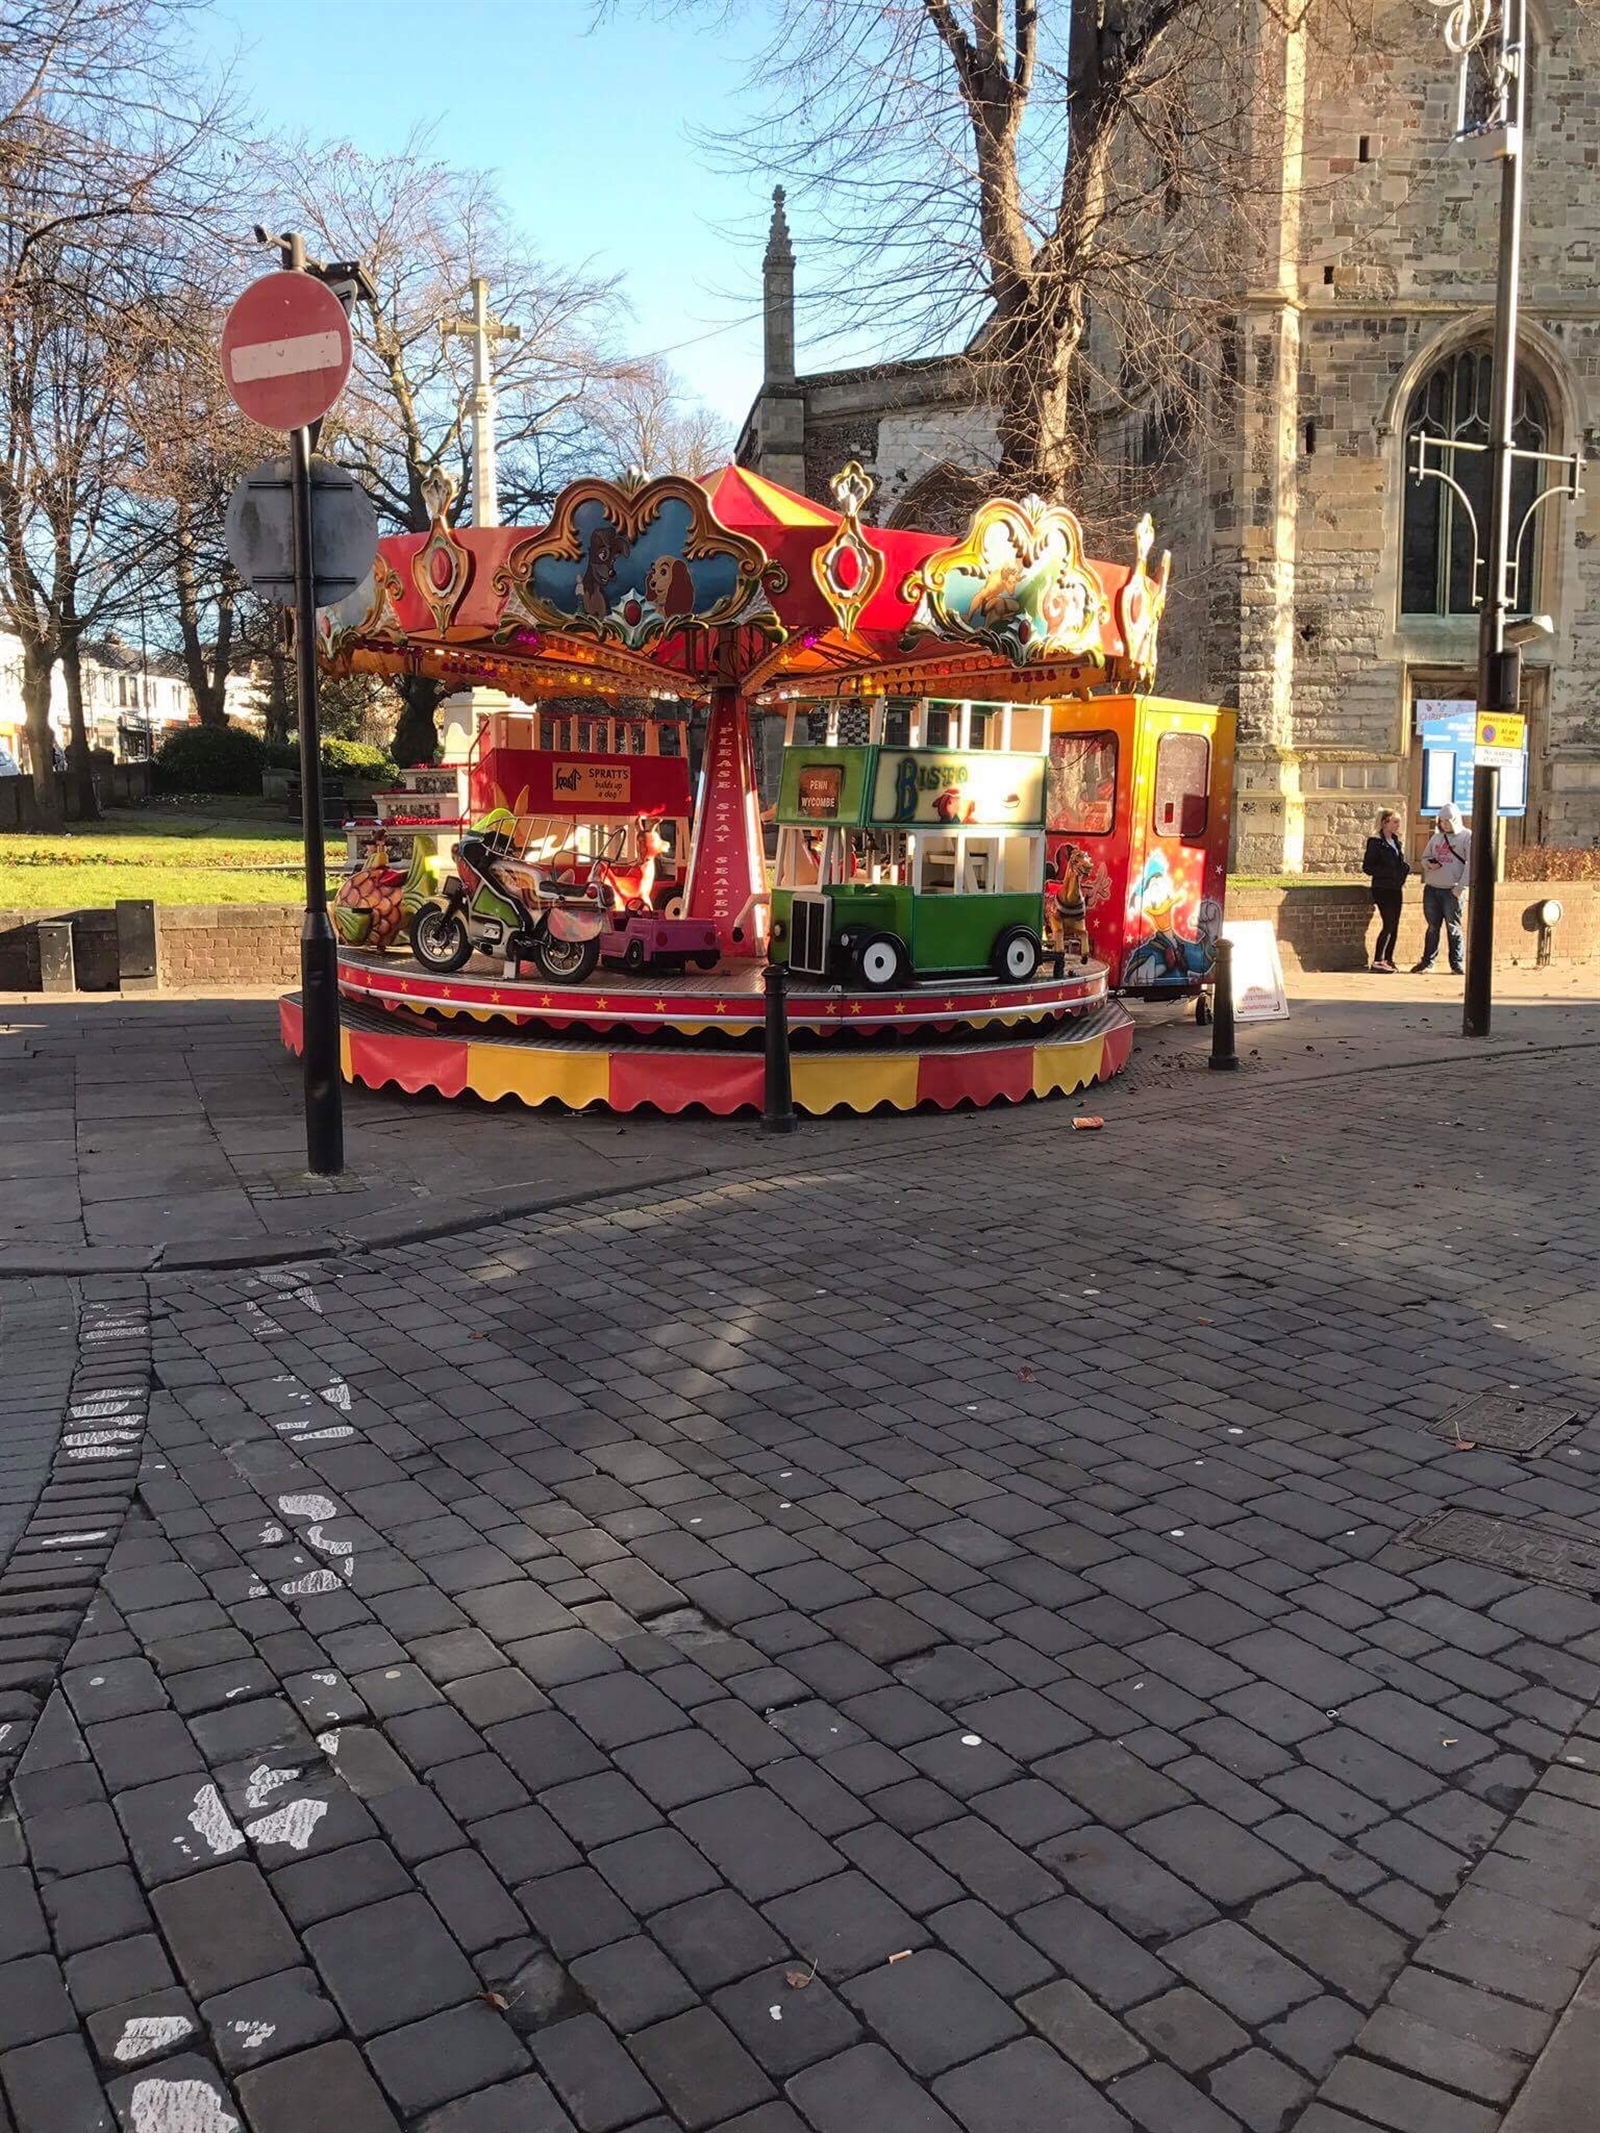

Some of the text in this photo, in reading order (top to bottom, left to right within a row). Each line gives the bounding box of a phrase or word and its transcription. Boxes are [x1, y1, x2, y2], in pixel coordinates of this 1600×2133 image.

[1480, 714, 1508, 723] Pedestrian
[716, 727, 733, 789] PLEASE
[809, 780, 828, 790] PENN
[801, 796, 835, 808] WYCOMBE
[714, 803, 731, 842] STAY
[712, 856, 729, 917] SEATED
